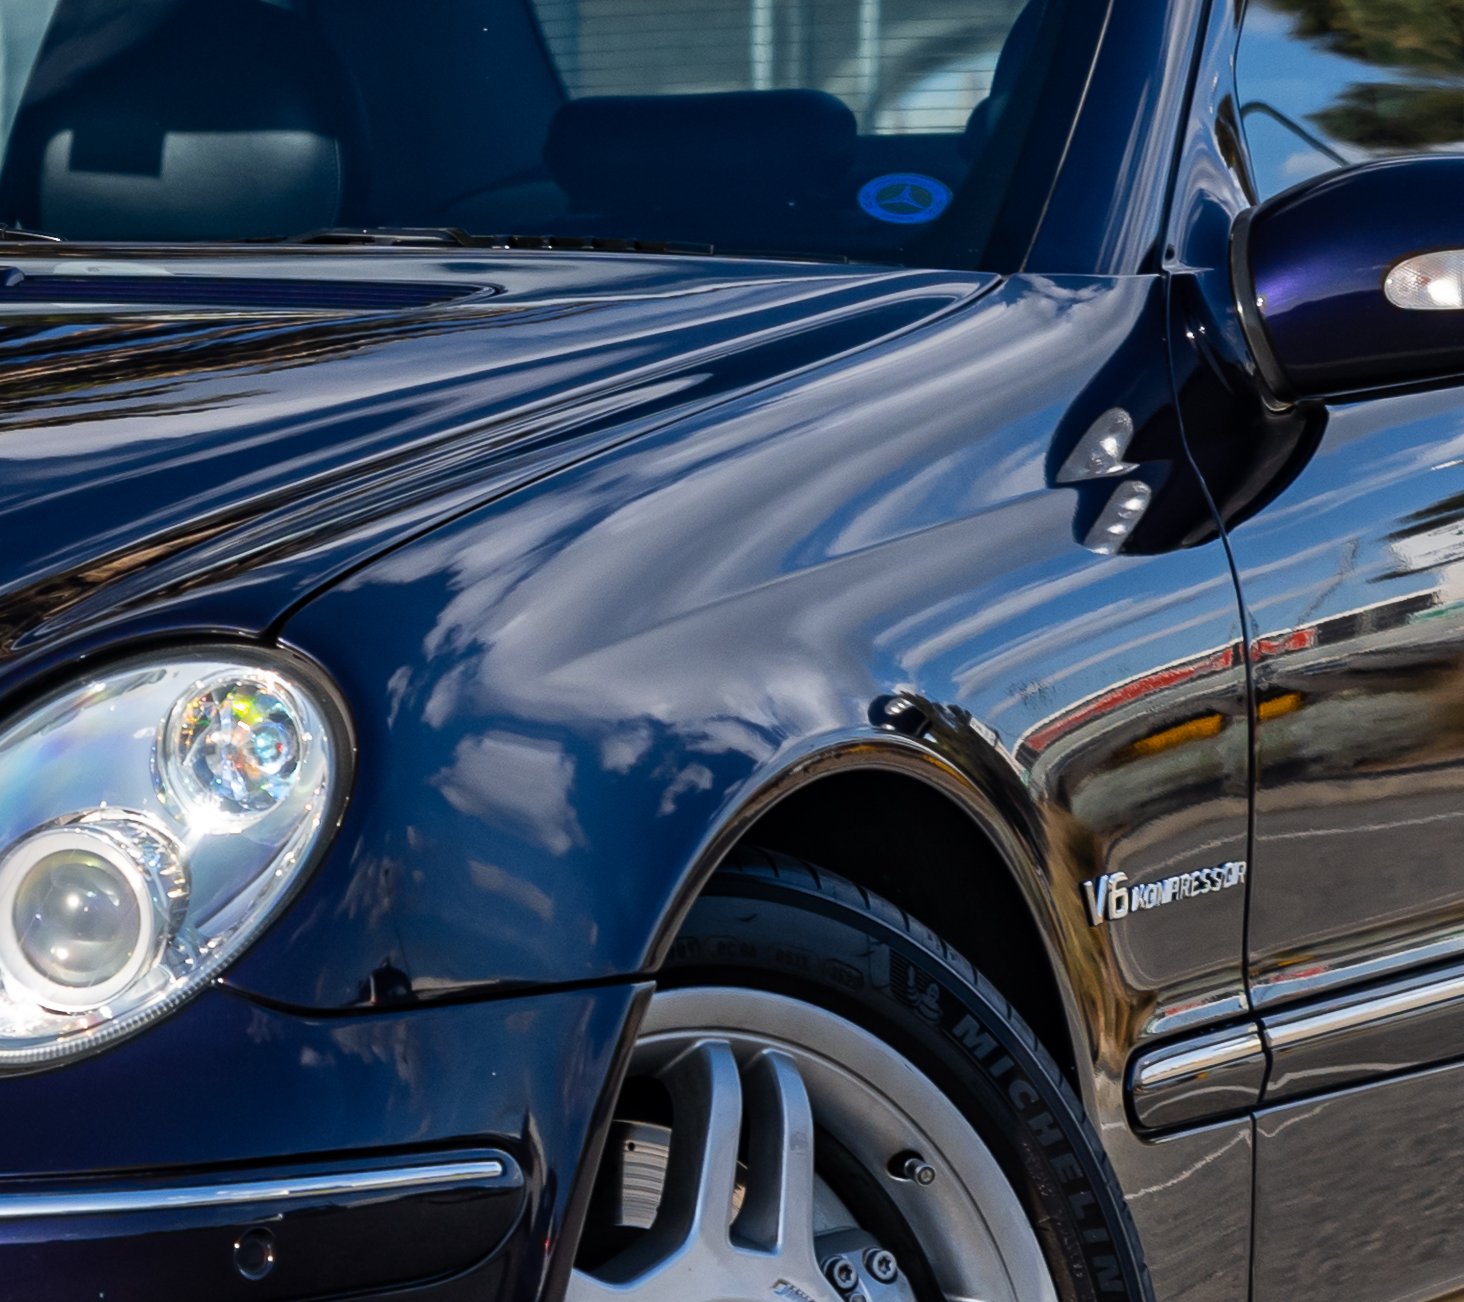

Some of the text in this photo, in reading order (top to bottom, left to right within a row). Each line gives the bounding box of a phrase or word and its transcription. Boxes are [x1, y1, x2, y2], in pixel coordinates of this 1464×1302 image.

[1083, 860, 1247, 926] V6 KOMPRESSOR
[951, 1013, 1125, 1293] MICHELIN
